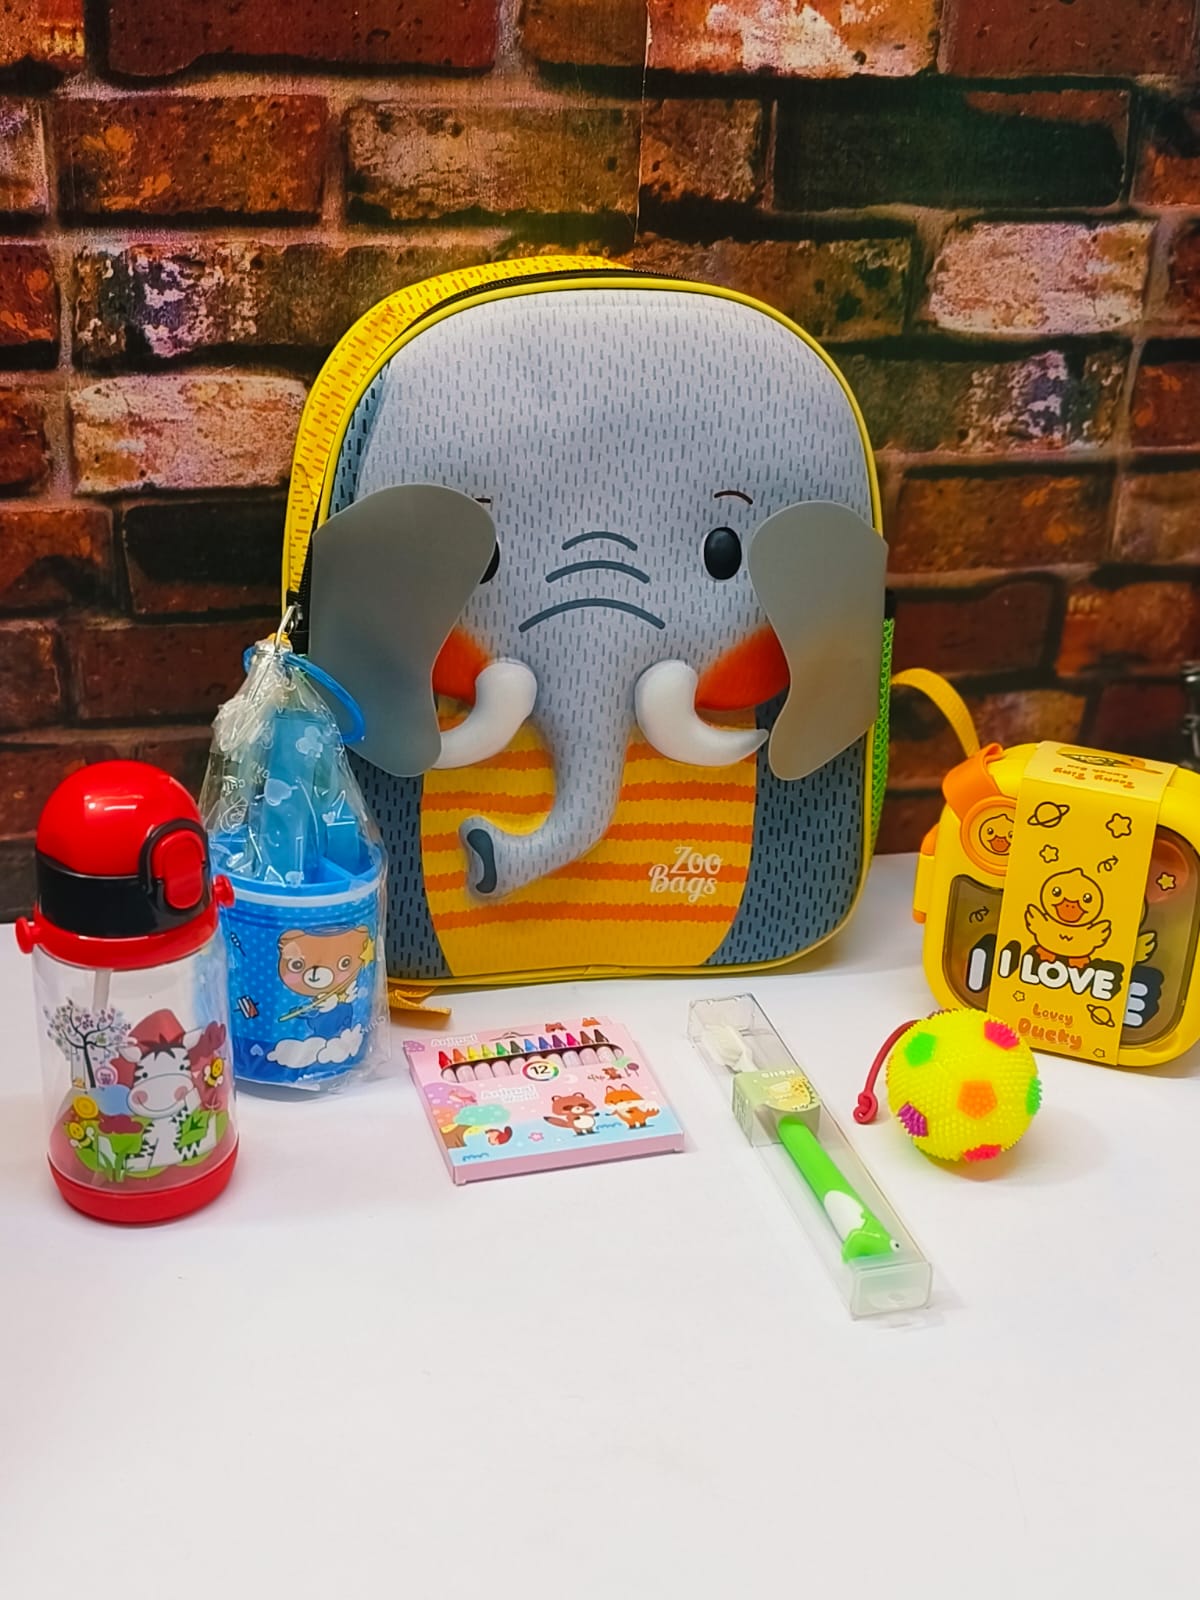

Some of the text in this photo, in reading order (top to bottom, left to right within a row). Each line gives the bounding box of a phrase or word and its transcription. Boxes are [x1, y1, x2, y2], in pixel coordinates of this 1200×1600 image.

[670, 845, 723, 875] Zoo
[648, 863, 717, 903] Bags
[999, 949, 1116, 1000] I LOVE
[1018, 1018, 1083, 1051] Ducky
[530, 1064, 551, 1075] 12
